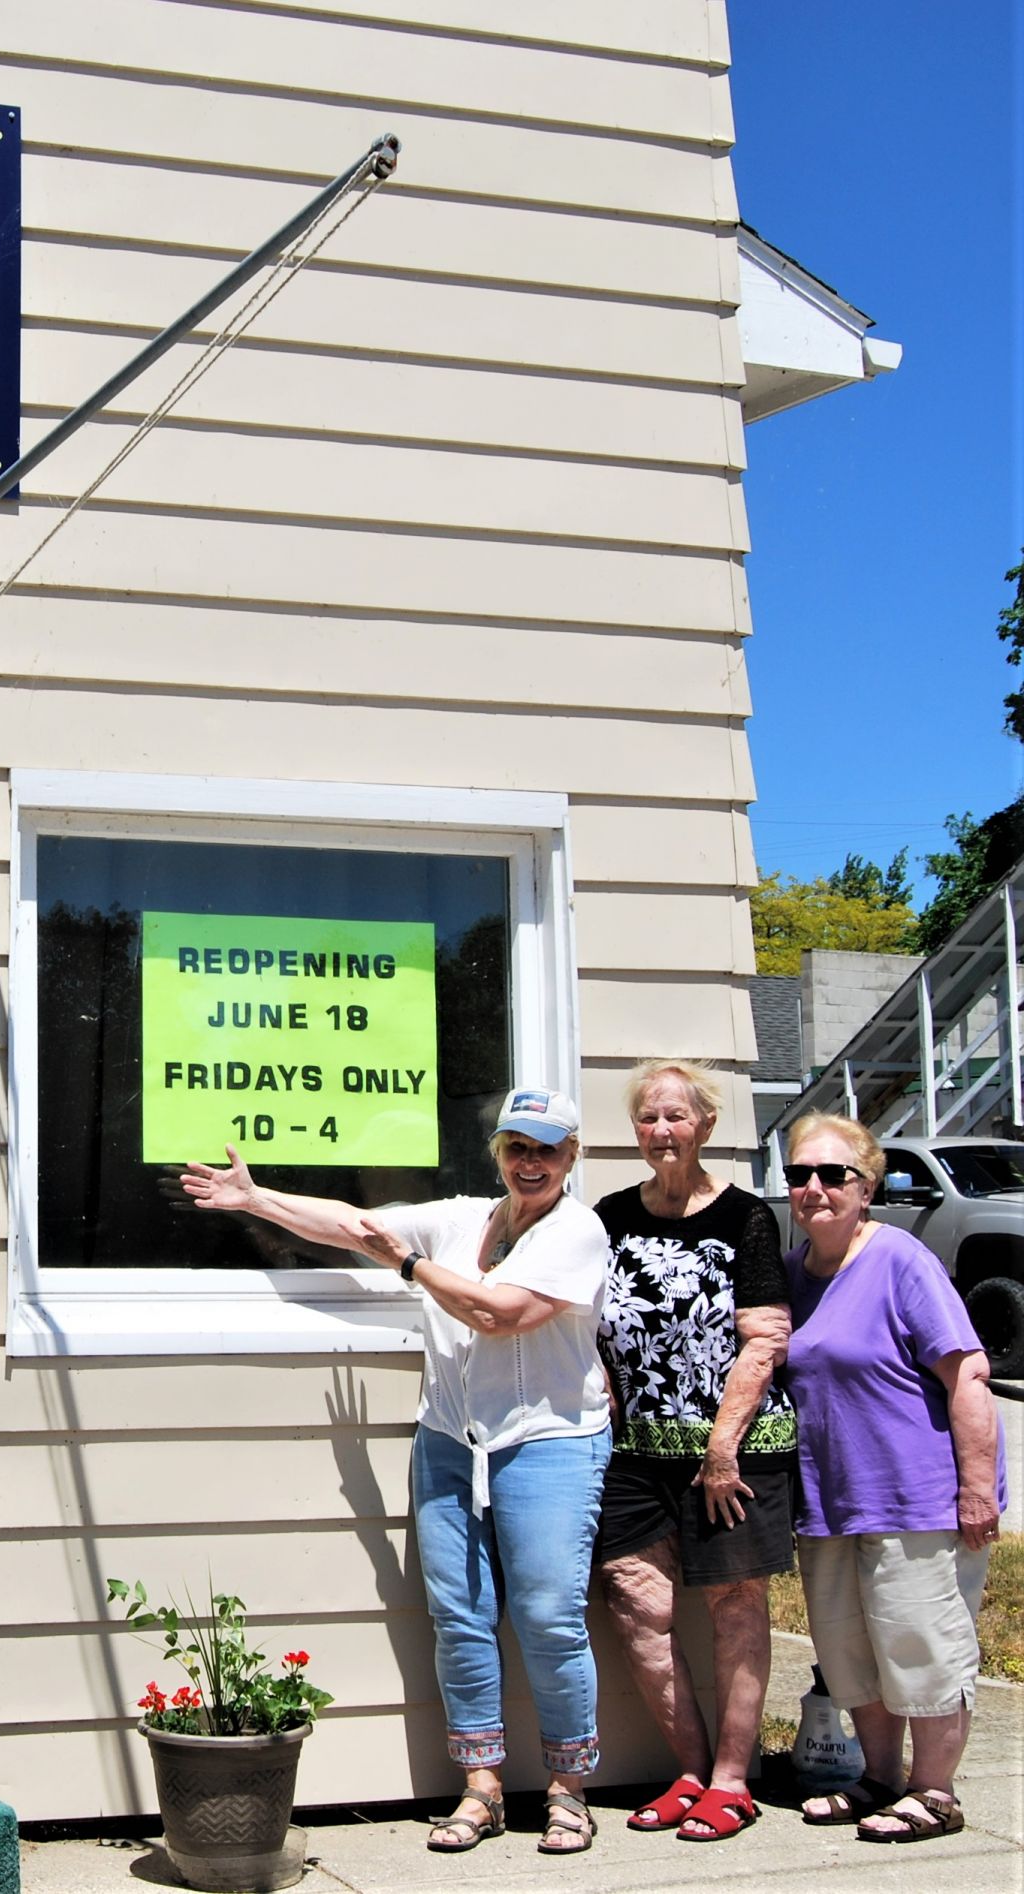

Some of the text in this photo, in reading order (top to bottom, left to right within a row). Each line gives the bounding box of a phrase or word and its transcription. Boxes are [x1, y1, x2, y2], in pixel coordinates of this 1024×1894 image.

[178, 947, 396, 979] REOPENING
[207, 1001, 368, 1032] JUNE 18
[164, 1061, 427, 1095] FRIDAYS ONLY
[231, 1114, 275, 1142] 10
[319, 1116, 339, 1143] 4
[806, 1737, 846, 1756] Downy
